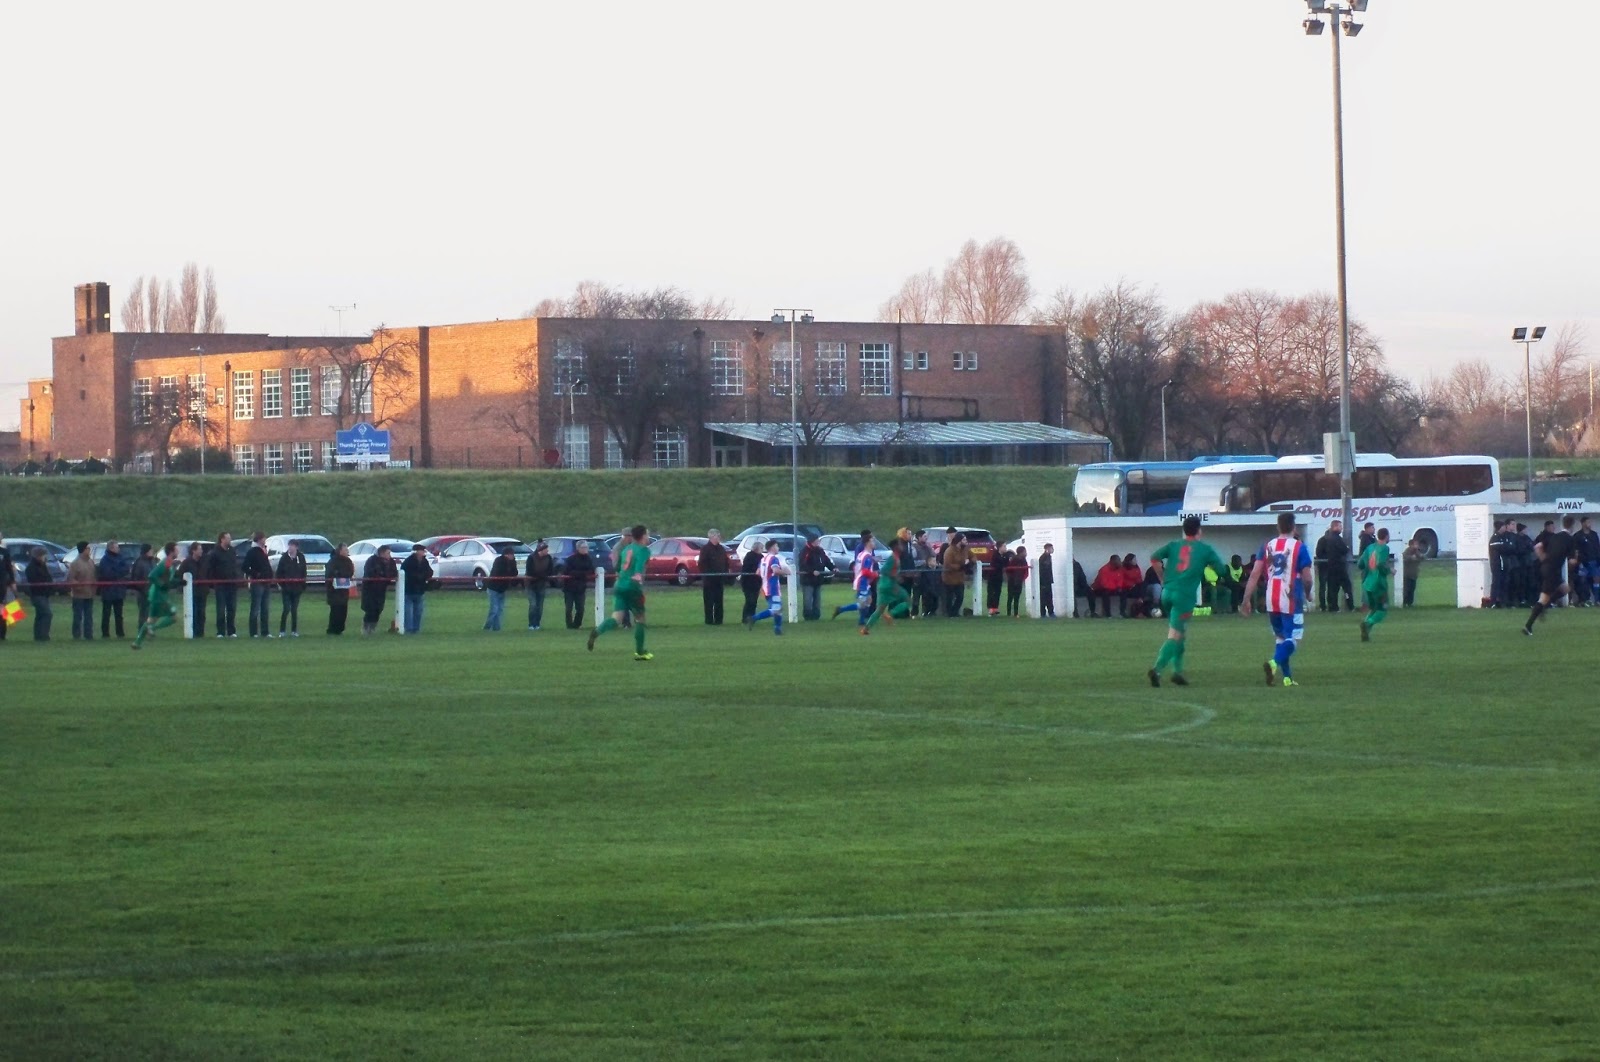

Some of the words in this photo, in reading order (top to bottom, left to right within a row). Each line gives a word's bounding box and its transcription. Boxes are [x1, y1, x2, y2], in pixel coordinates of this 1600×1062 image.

[1295, 504, 1411, 522] Bromsgrove
[1432, 504, 1448, 512] Coach
[1558, 502, 1584, 510] AWAY
[1273, 553, 1287, 576] 9
